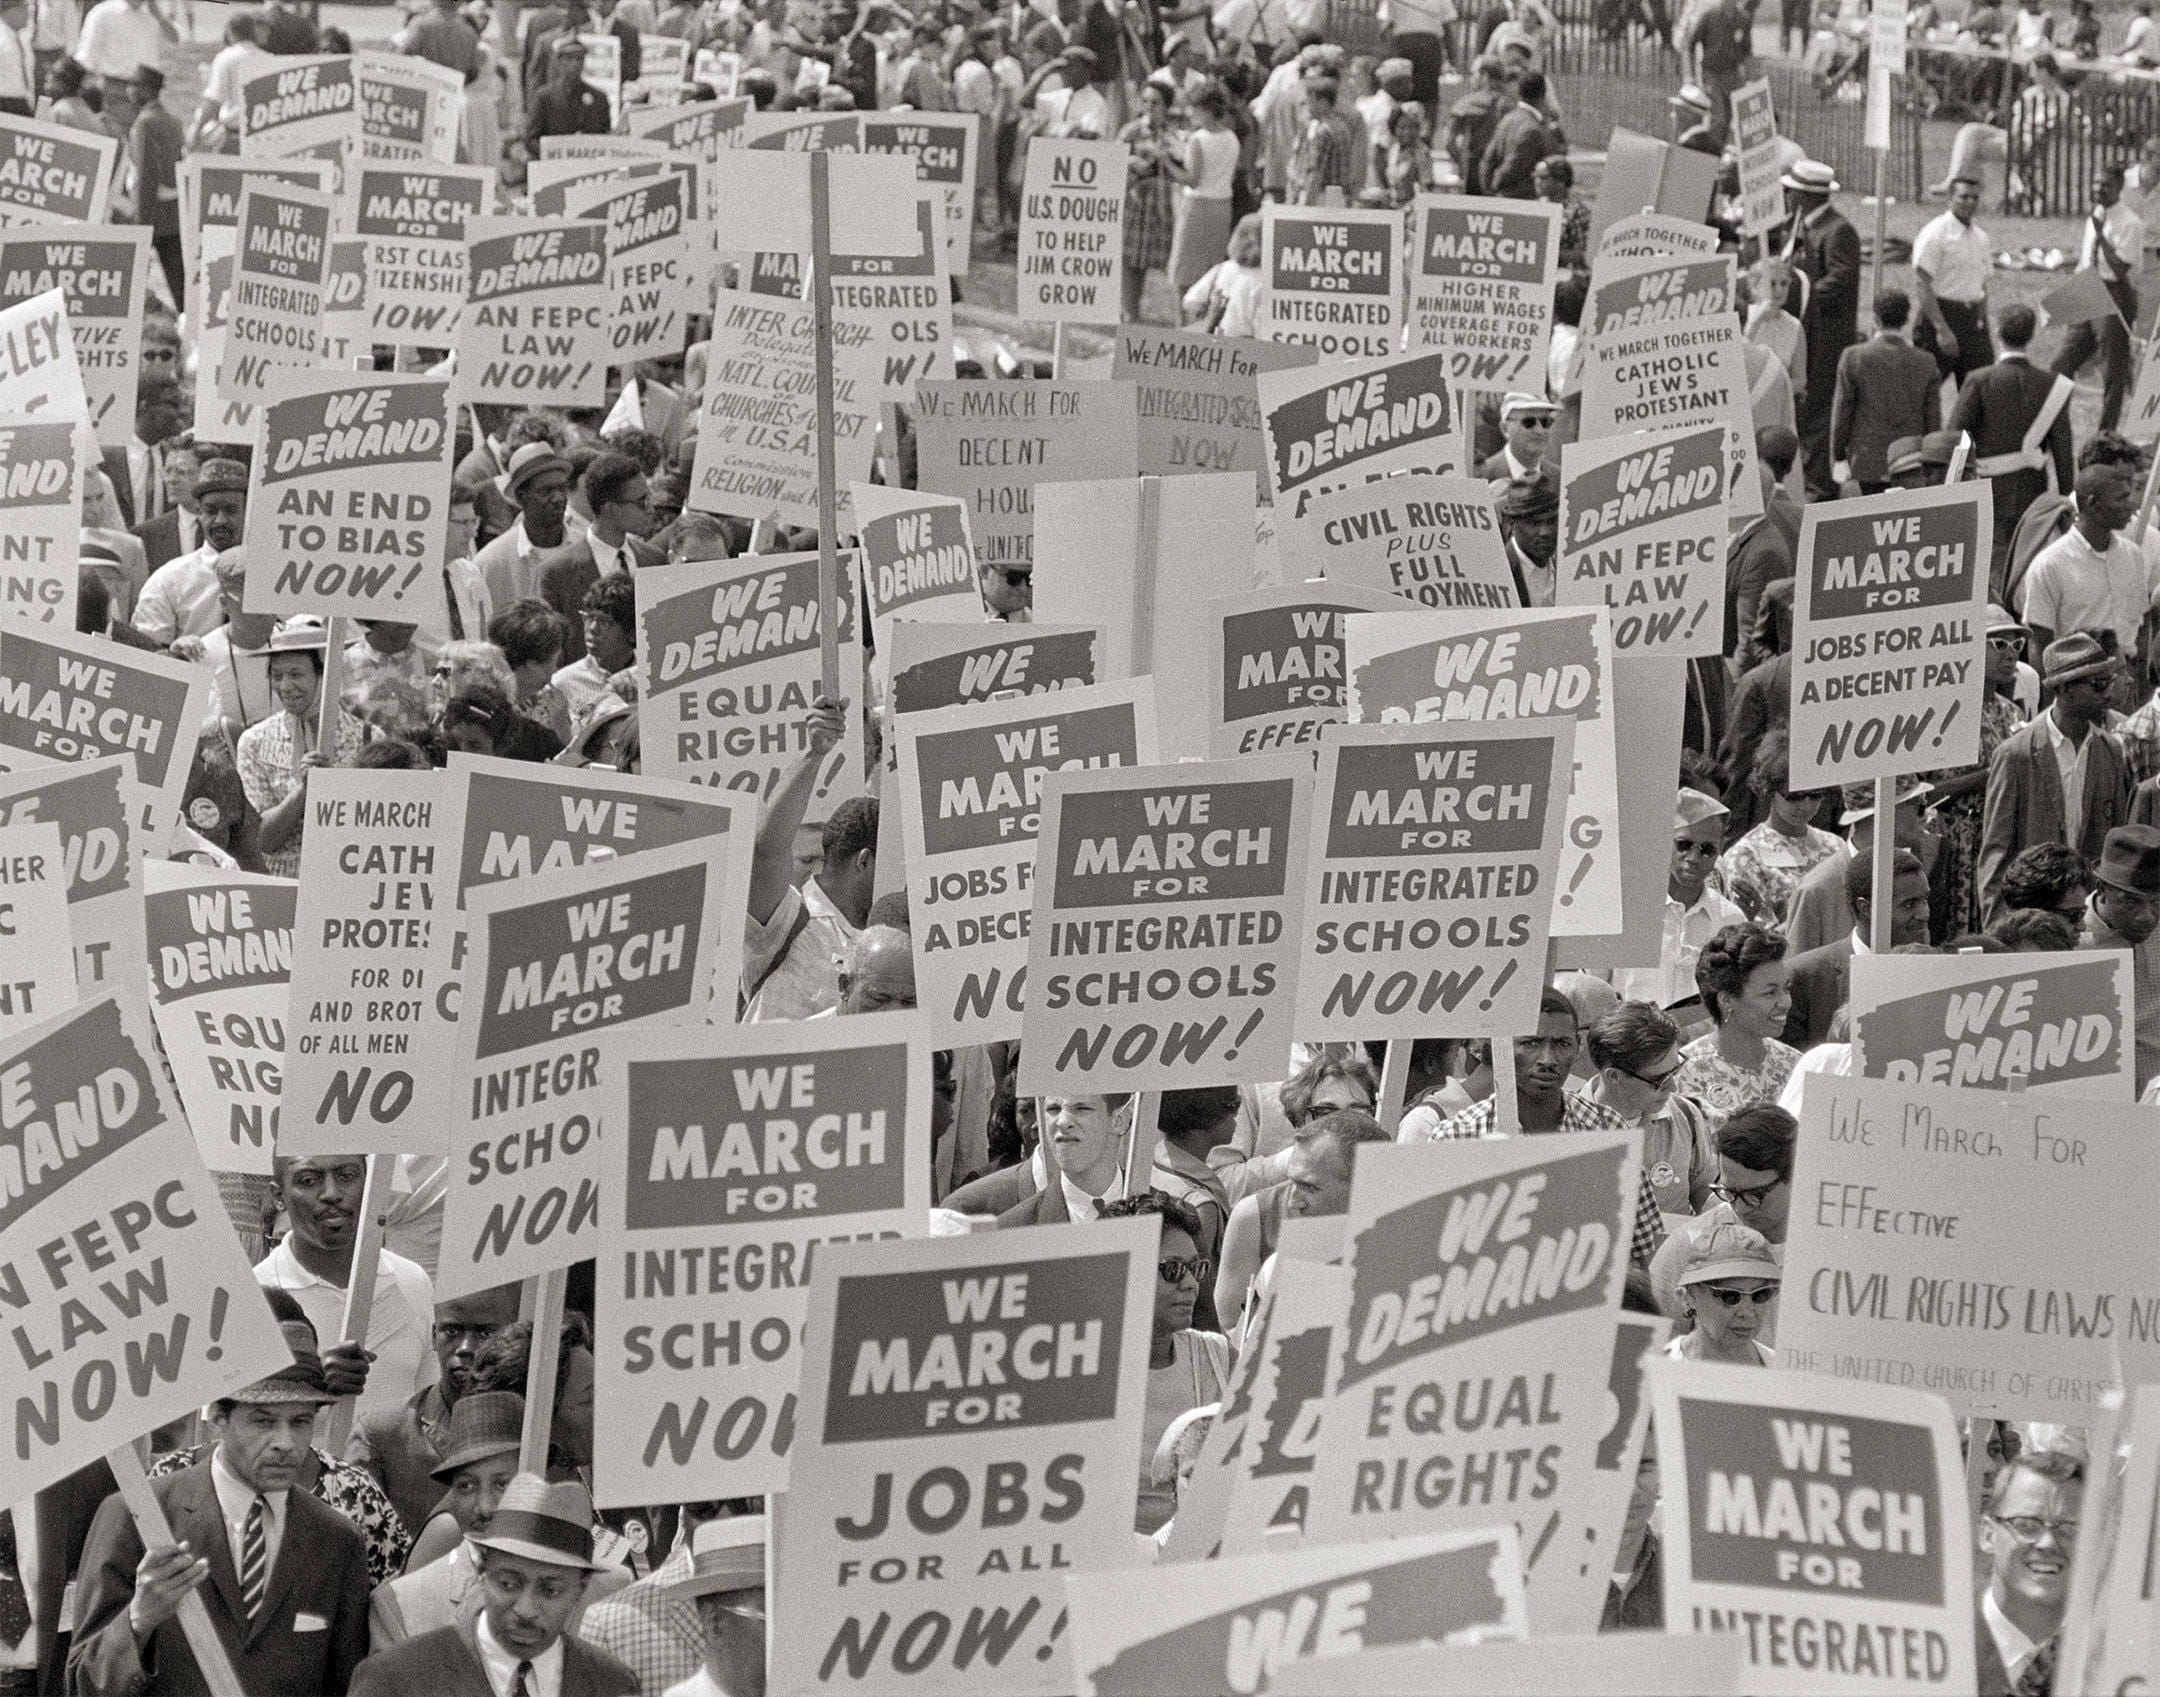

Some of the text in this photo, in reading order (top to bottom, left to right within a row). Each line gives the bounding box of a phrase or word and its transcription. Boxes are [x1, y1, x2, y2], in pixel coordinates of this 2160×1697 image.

[277, 68, 320, 96] WE
[253, 83, 353, 129] DEMAND
[402, 176, 440, 195] WE
[1053, 157, 1097, 184] NO
[277, 205, 304, 227] WE
[367, 196, 474, 224] MARCH
[1028, 196, 1119, 223] U.S. DOUGH
[1466, 215, 1503, 235] WE
[252, 227, 321, 263] MARCH
[396, 222, 439, 236] FOR
[512, 232, 563, 261] WE
[1037, 231, 1105, 252] TO HELP
[1312, 226, 1348, 247] WE
[1644, 227, 1708, 252] TOGETHER
[45, 245, 87, 267] WE
[1025, 257, 1112, 278] JIM CROW
[1279, 247, 1382, 275] MARCH
[1431, 235, 1537, 264] MARCH
[270, 260, 298, 276] FOR
[475, 253, 600, 296] DEMAND
[624, 260, 676, 288] FEPC
[1310, 276, 1350, 291] FOR
[1460, 261, 1502, 276] FOR
[1638, 269, 1688, 302] WE
[238, 280, 319, 317] INTEGRATED
[1039, 285, 1096, 305] GROW
[1417, 296, 1546, 319] MINIMUM WAGES
[1442, 281, 1520, 300] HIGHER
[477, 307, 601, 328] AN FEPC
[725, 305, 786, 336] INTER
[1273, 299, 1390, 325] INTEGRATED
[1419, 315, 1539, 337] COVERAGE FOR
[1601, 288, 1724, 335] DEMAND
[234, 318, 316, 351] SCHOOLS
[501, 335, 574, 355] LAW
[1422, 332, 1532, 351] ALL WORKERS
[1599, 328, 1732, 360] WE MARCH TOGETHER
[480, 362, 593, 390] NOW!
[1151, 340, 1222, 374] MARCH
[1229, 349, 1258, 377] FOR
[1615, 351, 1720, 384] CATHOLIC
[962, 391, 1036, 416] MARCH
[1050, 391, 1082, 416] FOR
[1325, 373, 1387, 423] WE
[1637, 375, 1699, 399] JEWS
[323, 390, 392, 427] WE
[711, 393, 798, 427] CHURCHES
[1614, 388, 1728, 424] PROTESTANT
[274, 418, 441, 474] DEMAND
[959, 438, 1050, 466] DECENT
[1287, 392, 1442, 477] DEMAND
[701, 467, 785, 501] RELIGION
[1616, 446, 1675, 494] WE
[277, 488, 431, 522] AN END
[1574, 465, 1718, 543] DEMAND
[277, 524, 426, 558] TO BIAS
[896, 513, 932, 554] WE
[1324, 502, 1492, 546] CIVIL RIGHTS
[1873, 517, 1921, 546] WE
[1386, 532, 1451, 559] PLUS
[1574, 536, 1716, 581] AN FEPC
[274, 560, 423, 600] NOW!
[879, 544, 971, 604] DEMAND
[1389, 554, 1466, 586] FULL
[1823, 543, 1964, 591] MARCH
[1603, 573, 1688, 610] LAW
[1865, 587, 1921, 608] FOR
[1433, 632, 1521, 688] WE
[1803, 620, 1973, 664] JOBS FOR ALL
[58, 656, 116, 700] WE
[1800, 659, 1972, 705] A DECENT PAY
[0, 676, 163, 755] MARCH
[1817, 699, 1960, 766] NOW!
[34, 730, 100, 761] FOR
[1415, 750, 1478, 782] WE
[316, 800, 433, 829] WE MARCH
[1143, 793, 1212, 826] WE
[1345, 783, 1533, 826] MARCH
[1073, 827, 1273, 876] MARCH
[1400, 830, 1473, 850] FOR
[924, 864, 1007, 905] JOBS
[1132, 876, 1210, 897] FOR
[1320, 863, 1540, 905] INTEGRATED
[567, 893, 632, 942] WE
[1050, 909, 1284, 957] INTEGRATED
[1314, 914, 1531, 955] SCHOOLS
[351, 969, 388, 989] FOR
[497, 925, 686, 1015] MARCH
[1046, 961, 1277, 1009] SCHOOLS
[1321, 957, 1519, 1019] NOW!
[309, 1000, 353, 1023] AND
[552, 993, 623, 1033] FOR
[1944, 978, 2039, 1040] WE
[300, 1033, 409, 1054] OF ALL MEN
[1054, 1007, 1265, 1073] NOW!
[732, 1064, 816, 1112] WE
[647, 1110, 887, 1182] MARCH
[2034, 1114, 2087, 1166] FOR
[725, 1182, 818, 1215] FOR
[1816, 1181, 1960, 1239] EFFECTIVE
[36, 1180, 198, 1291] FEPC
[1438, 1173, 1549, 1264] WE
[942, 1274, 1028, 1325] WE
[1355, 1222, 1611, 1365] DEMAND
[1809, 1267, 2115, 1339] CIVIL RIGHTS LAWS
[11, 1256, 169, 1372] LAW
[15, 1286, 230, 1461] NOW!
[847, 1319, 1101, 1398] MARCH
[1784, 1347, 2040, 1397] THE UNITED CHURCH OF
[925, 1393, 1024, 1427] FOR
[1366, 1372, 1562, 1440] EQUAL
[1773, 1417, 1853, 1476] WE
[834, 1453, 1086, 1542] JOBS
[1350, 1444, 1562, 1516] RIGHTS
[1705, 1470, 1926, 1556] MARCH
[836, 1544, 1072, 1588] FOR ALL
[1776, 1551, 1865, 1590] FOR
[817, 1595, 1069, 1684] NOW!
